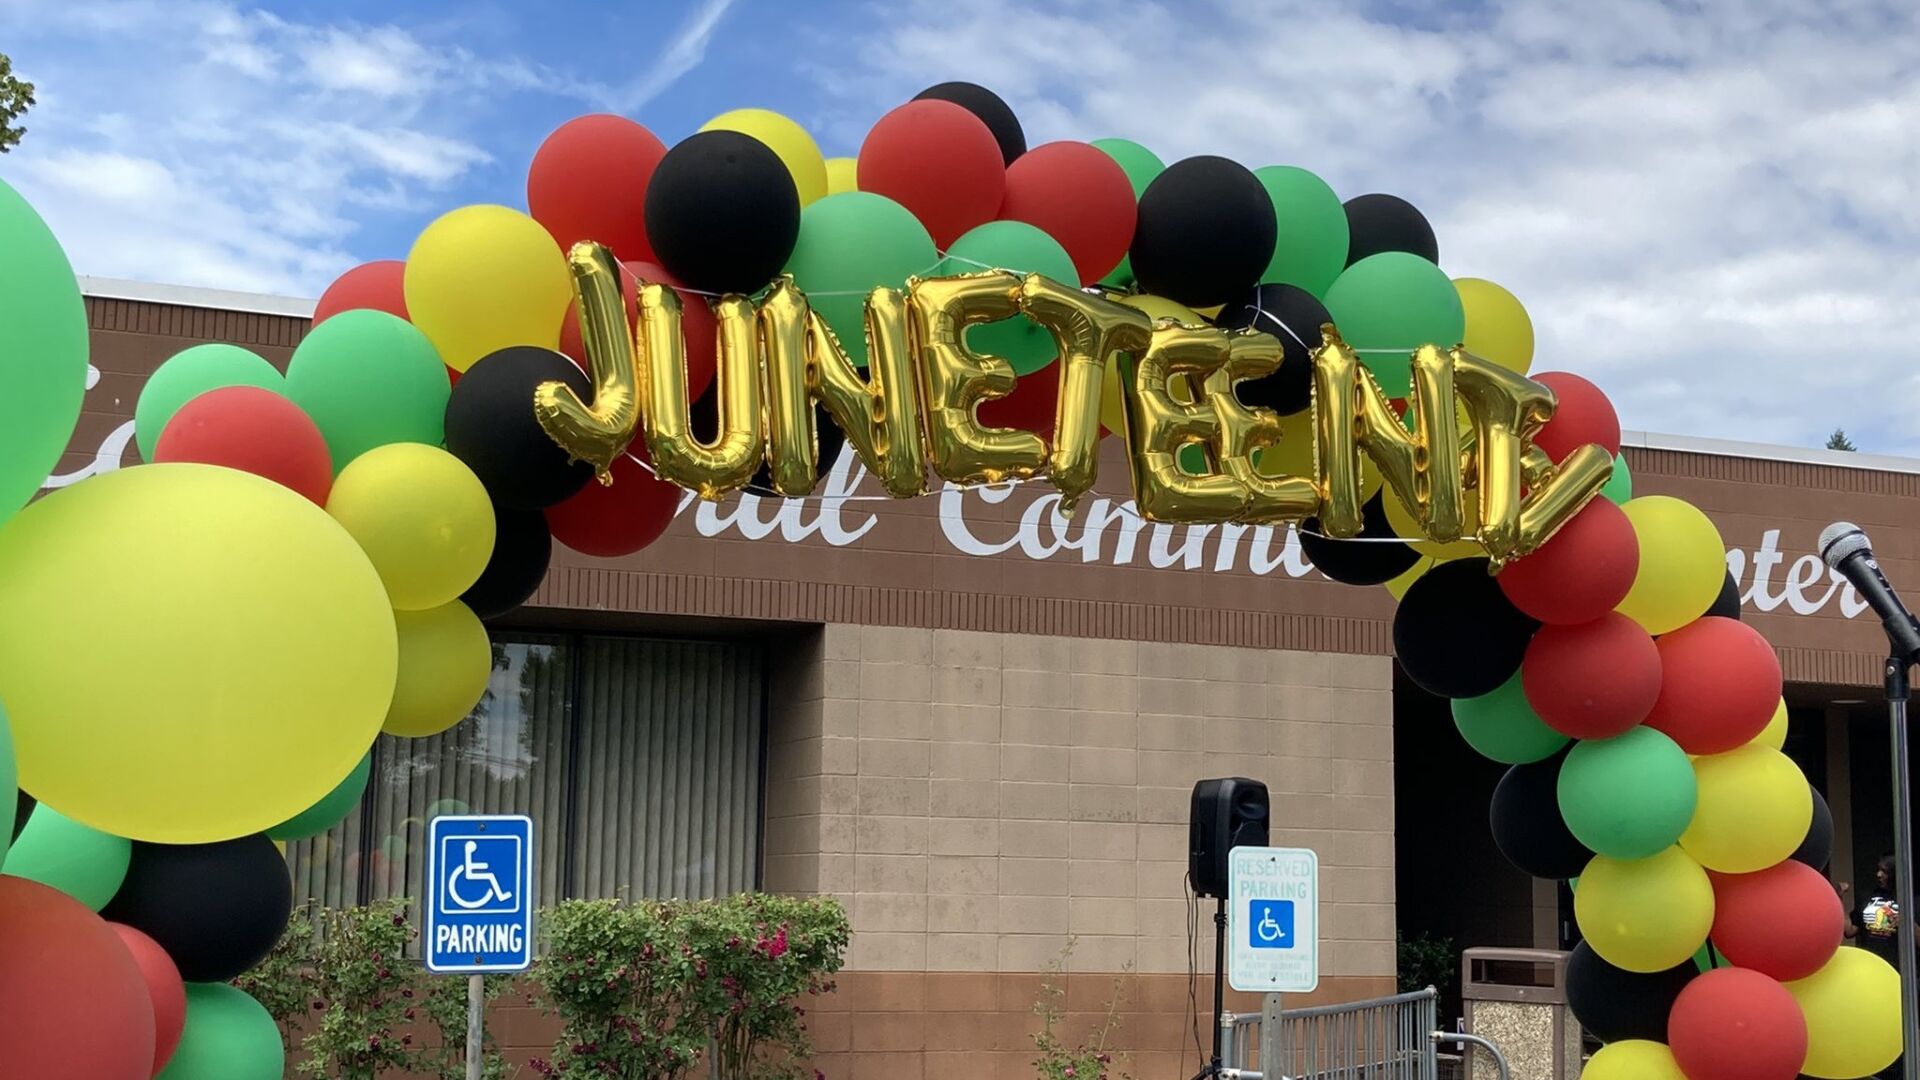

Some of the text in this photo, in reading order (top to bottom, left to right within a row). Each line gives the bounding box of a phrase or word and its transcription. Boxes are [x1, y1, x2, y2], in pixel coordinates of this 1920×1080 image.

[1237, 857, 1311, 878] RESERVED
[1240, 880, 1307, 899] PARKING
[436, 923, 522, 954] PARKING
